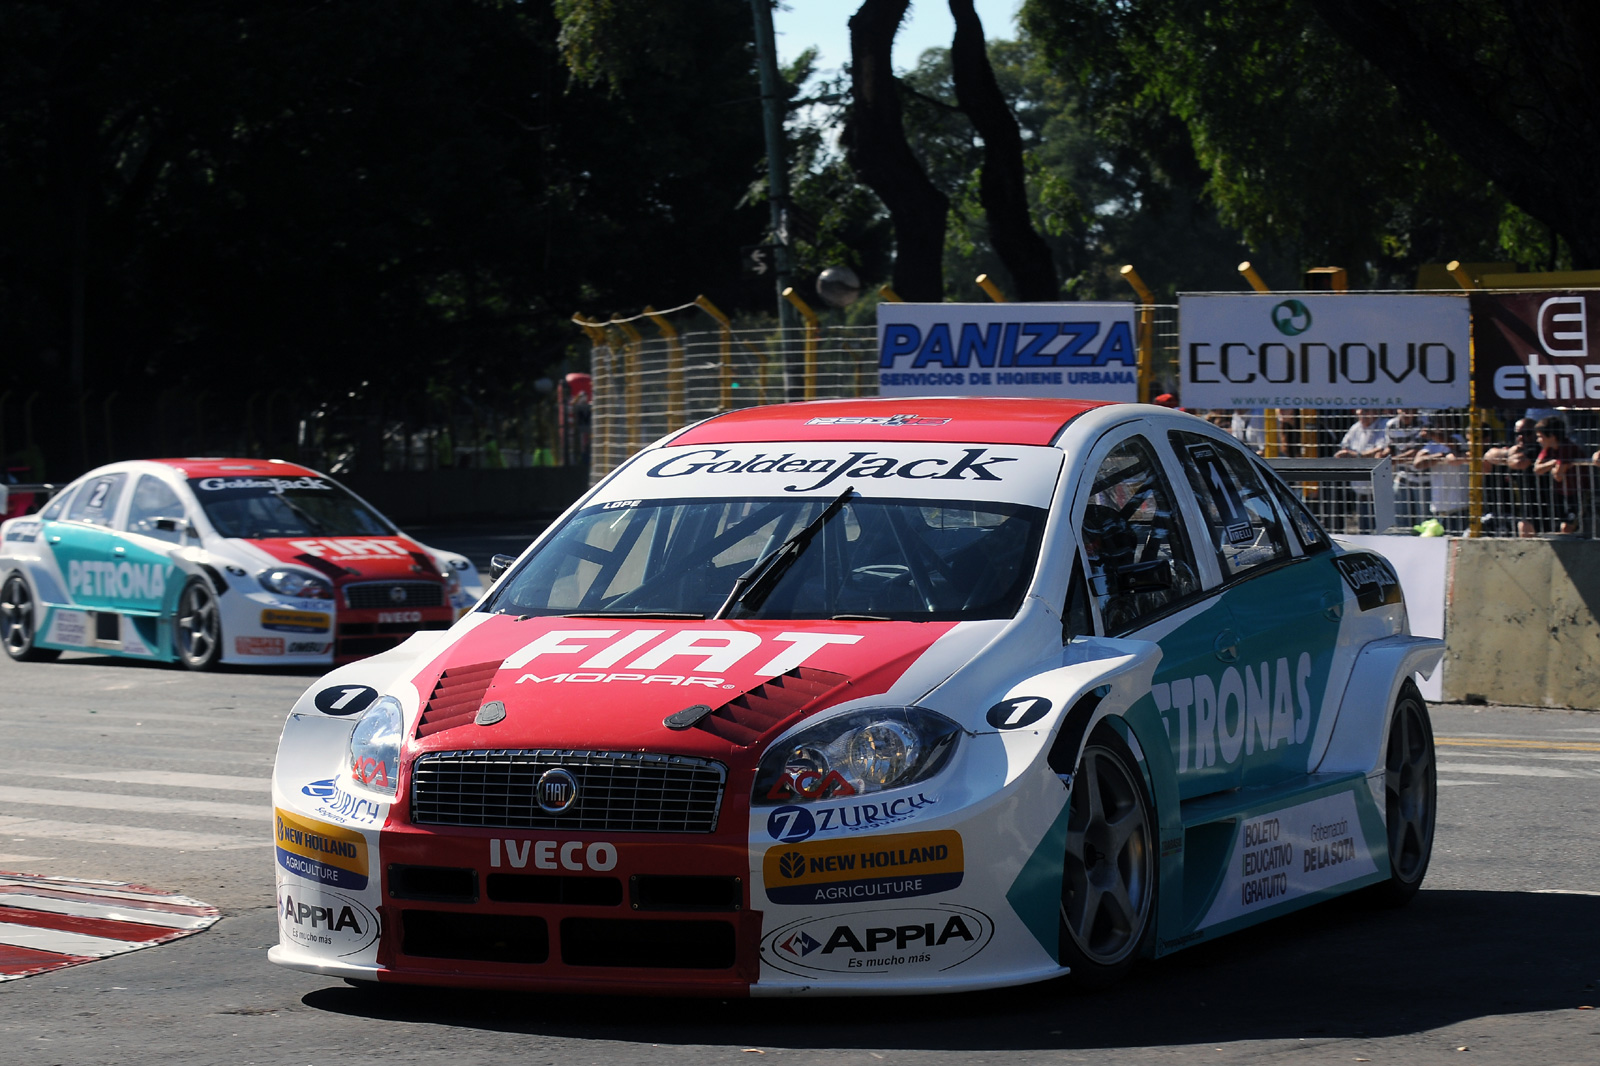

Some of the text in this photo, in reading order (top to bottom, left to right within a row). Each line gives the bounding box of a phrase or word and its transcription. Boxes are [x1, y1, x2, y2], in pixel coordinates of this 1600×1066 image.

[879, 321, 1136, 368] PANIZZA
[880, 371, 1136, 386] SERVICIOS DE HIGIENE URBANA
[1230, 396, 1404, 406] WWW.ECONOVO.COM.AR
[1207, 461, 1239, 519] 1
[1226, 520, 1253, 542] PIRELLI
[289, 539, 409, 557] FIAT
[378, 611, 421, 623] IVECO
[498, 629, 865, 677] FIAT
[330, 687, 369, 710] 1
[1003, 699, 1039, 725] 1
[545, 783, 567, 801] FIAT
[815, 793, 936, 831] ZURICH
[284, 825, 357, 859] NEW HOLLAND
[490, 838, 618, 872] IVECO
[285, 855, 339, 882] AGRICULTURE
[810, 844, 948, 873] NEW HOLLAND
[815, 879, 923, 900] AGRICULTURE
[284, 895, 363, 935] APPIA
[318, 933, 332, 945] más
[821, 916, 974, 954] APPIA
[848, 952, 931, 968] Es mucho más
